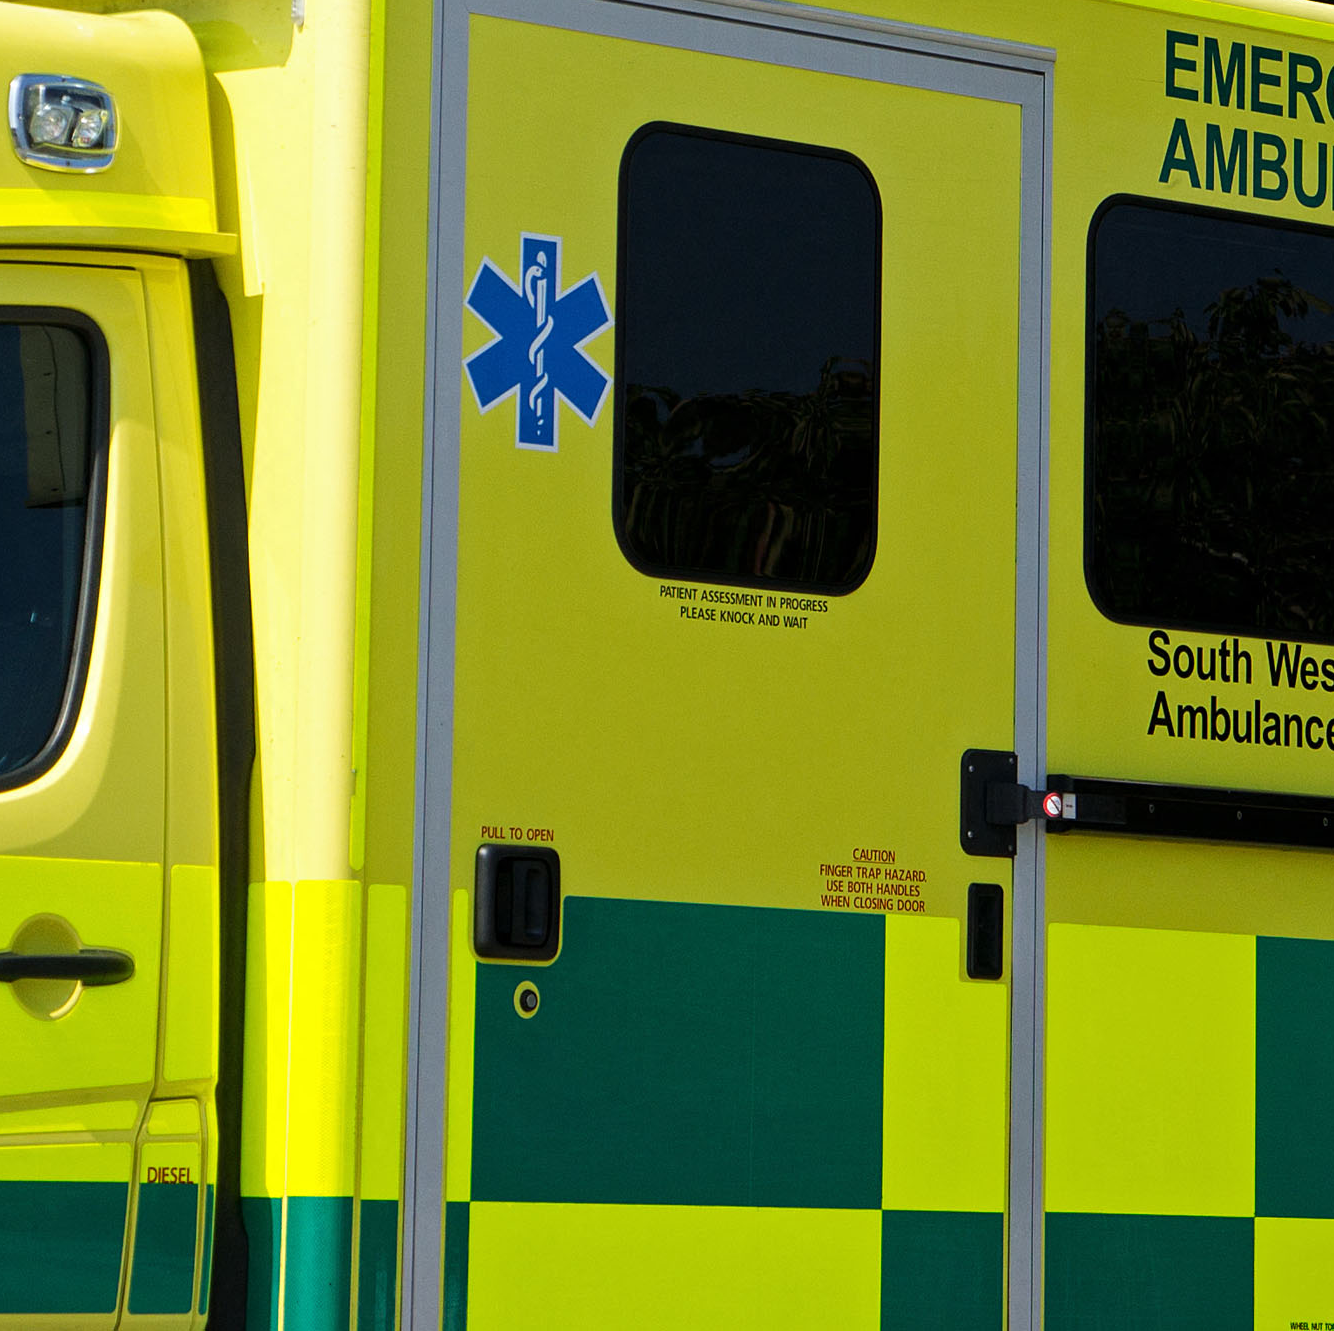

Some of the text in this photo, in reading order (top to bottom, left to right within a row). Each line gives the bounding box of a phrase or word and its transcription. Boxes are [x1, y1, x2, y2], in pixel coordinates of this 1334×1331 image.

[660, 585, 828, 613] PATIENT ASSESSMENT IN PROGRESS
[680, 606, 808, 629] PLEASE KNOCK AND WAIT
[1147, 629, 1252, 685] South
[481, 826, 554, 842] PULL TO OPEN
[852, 848, 895, 863] CAUTION
[820, 864, 927, 883] FINGER TRAP HAZARD.
[826, 880, 920, 897] USE BOTH HANDLES
[821, 895, 925, 912] WHEN CLOSING DOOR
[147, 1167, 194, 1184] DIESEL
